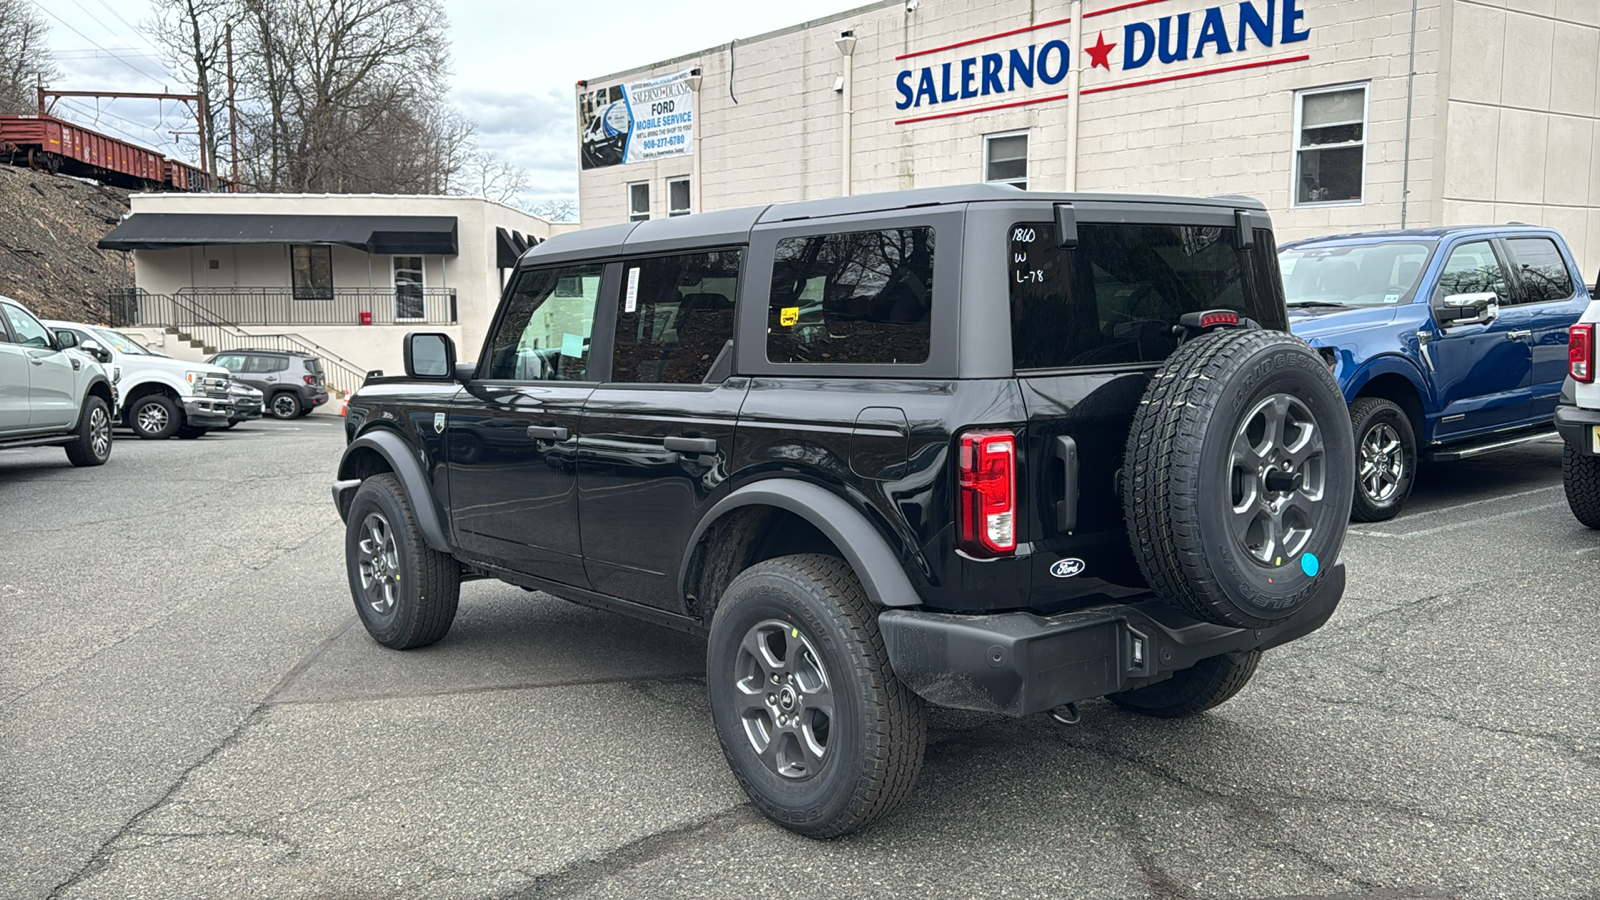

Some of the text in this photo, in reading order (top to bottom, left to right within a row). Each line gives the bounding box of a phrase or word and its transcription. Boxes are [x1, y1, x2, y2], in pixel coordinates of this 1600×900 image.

[895, 0, 1311, 110] SALERNO DUANE
[651, 100, 675, 116] FORD
[636, 117, 661, 131] MOBILE
[662, 111, 692, 126] SERVICE
[643, 134, 685, 150] 908-277-6780
[1012, 228, 1036, 243] 1860
[1016, 269, 1044, 283] L-78
[1056, 560, 1080, 575] Ford
